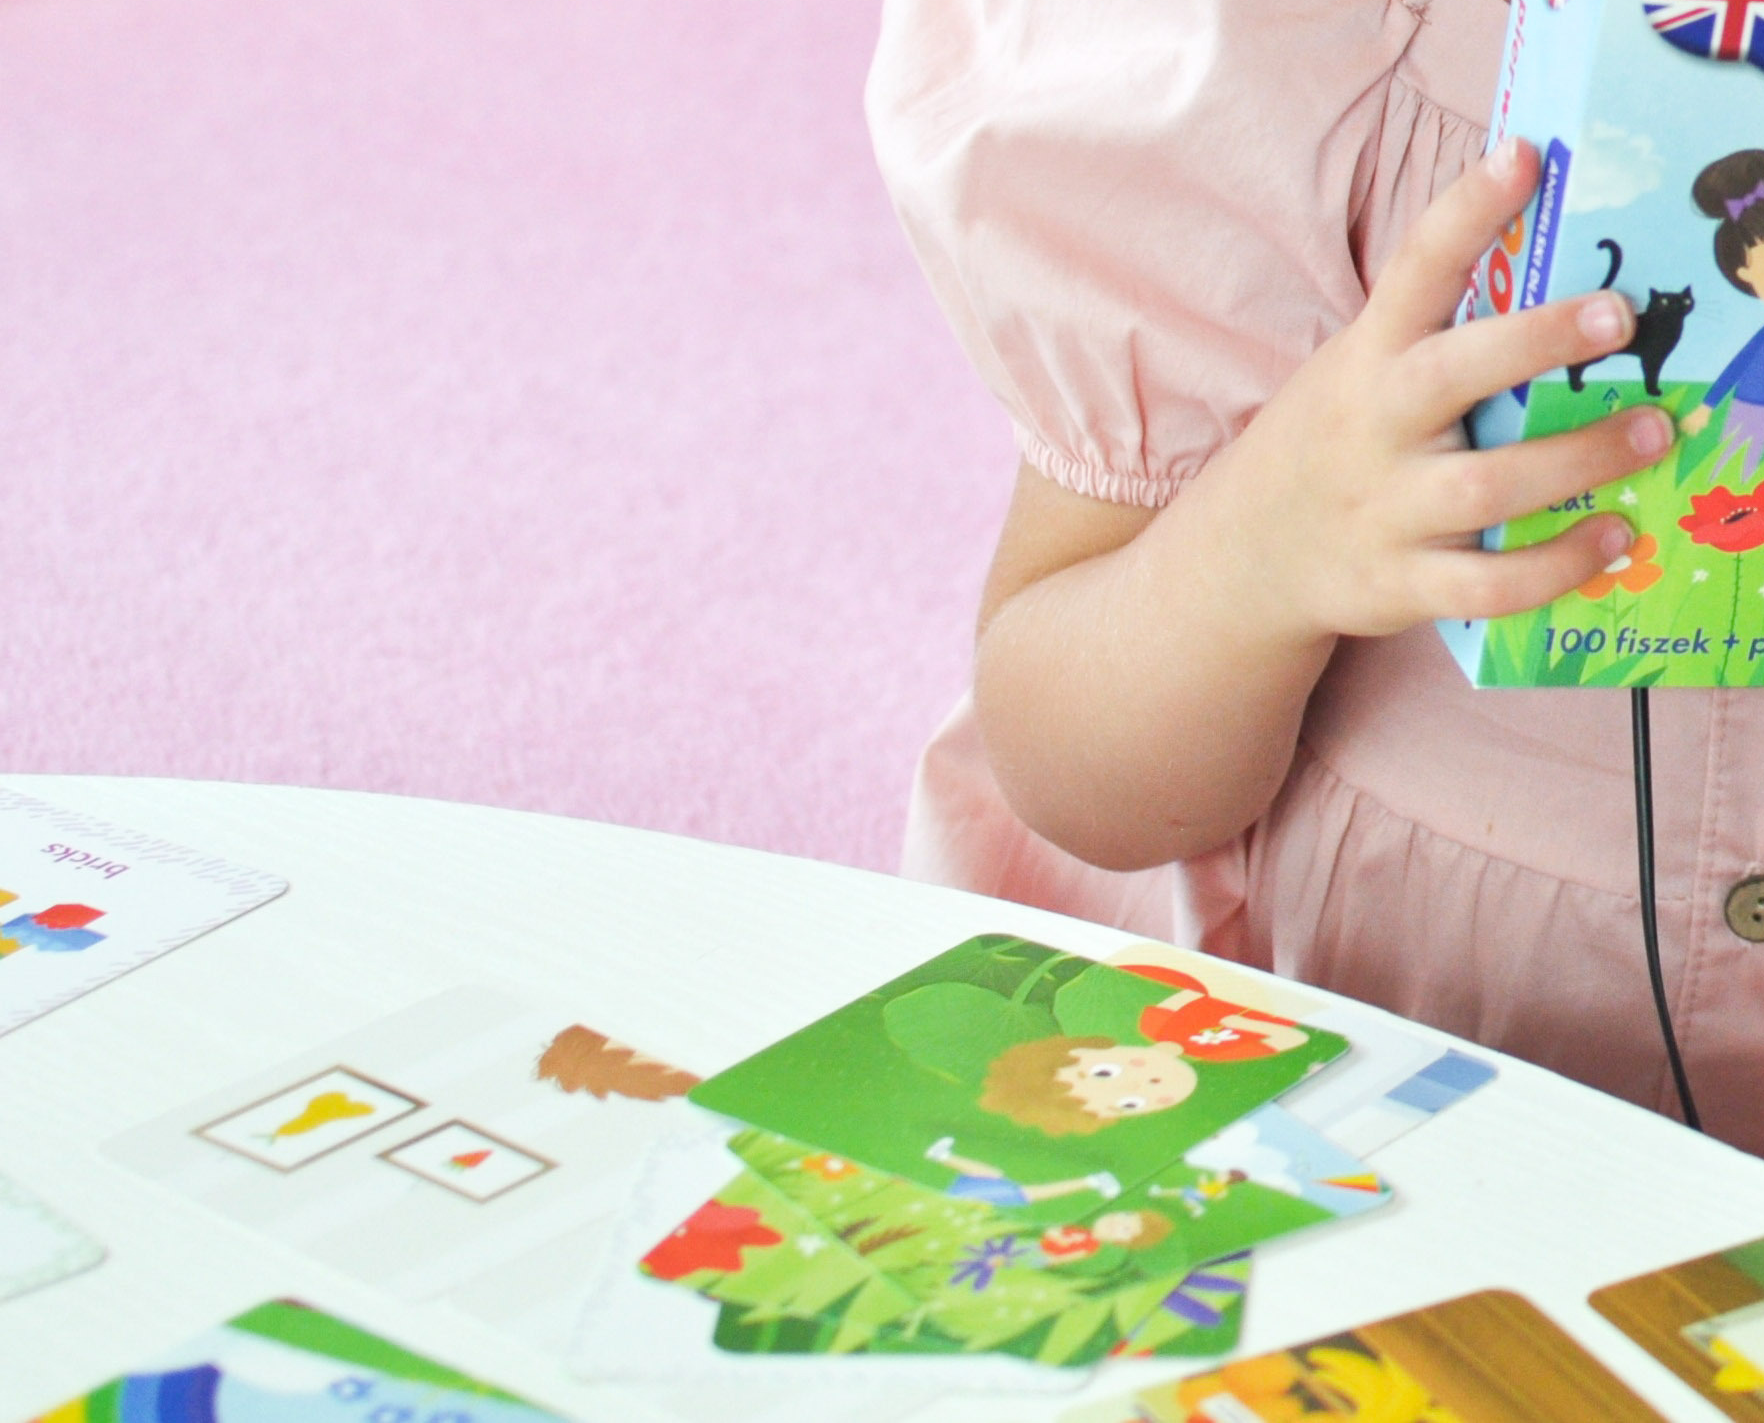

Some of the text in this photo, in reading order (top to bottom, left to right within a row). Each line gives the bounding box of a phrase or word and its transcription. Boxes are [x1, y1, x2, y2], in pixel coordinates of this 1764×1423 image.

[1542, 627, 1607, 654] 100
[1614, 627, 1710, 656] fiszek
[40, 843, 131, 879] bricks
